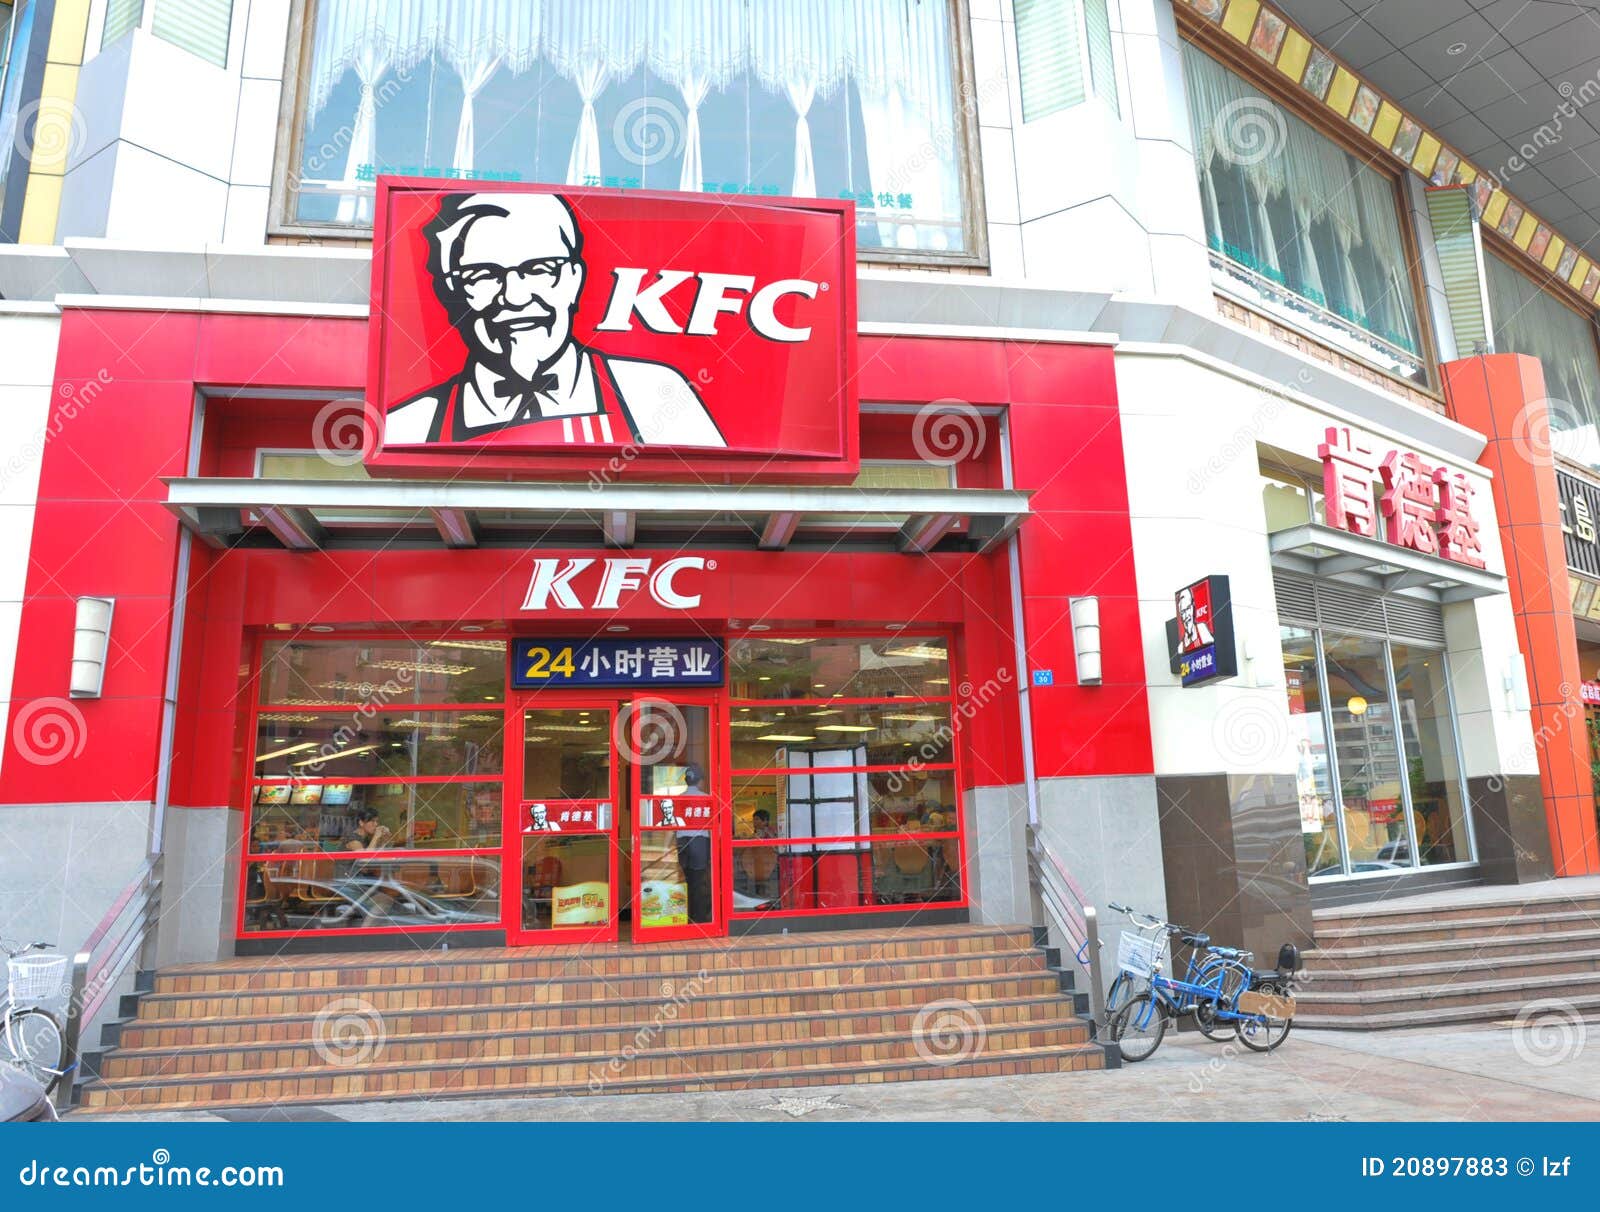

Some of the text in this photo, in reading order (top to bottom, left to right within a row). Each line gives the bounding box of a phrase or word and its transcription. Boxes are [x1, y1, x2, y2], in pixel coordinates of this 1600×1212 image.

[593, 267, 818, 342] KFC
[1318, 427, 1486, 570] 肯德基
[519, 556, 705, 610] KFC
